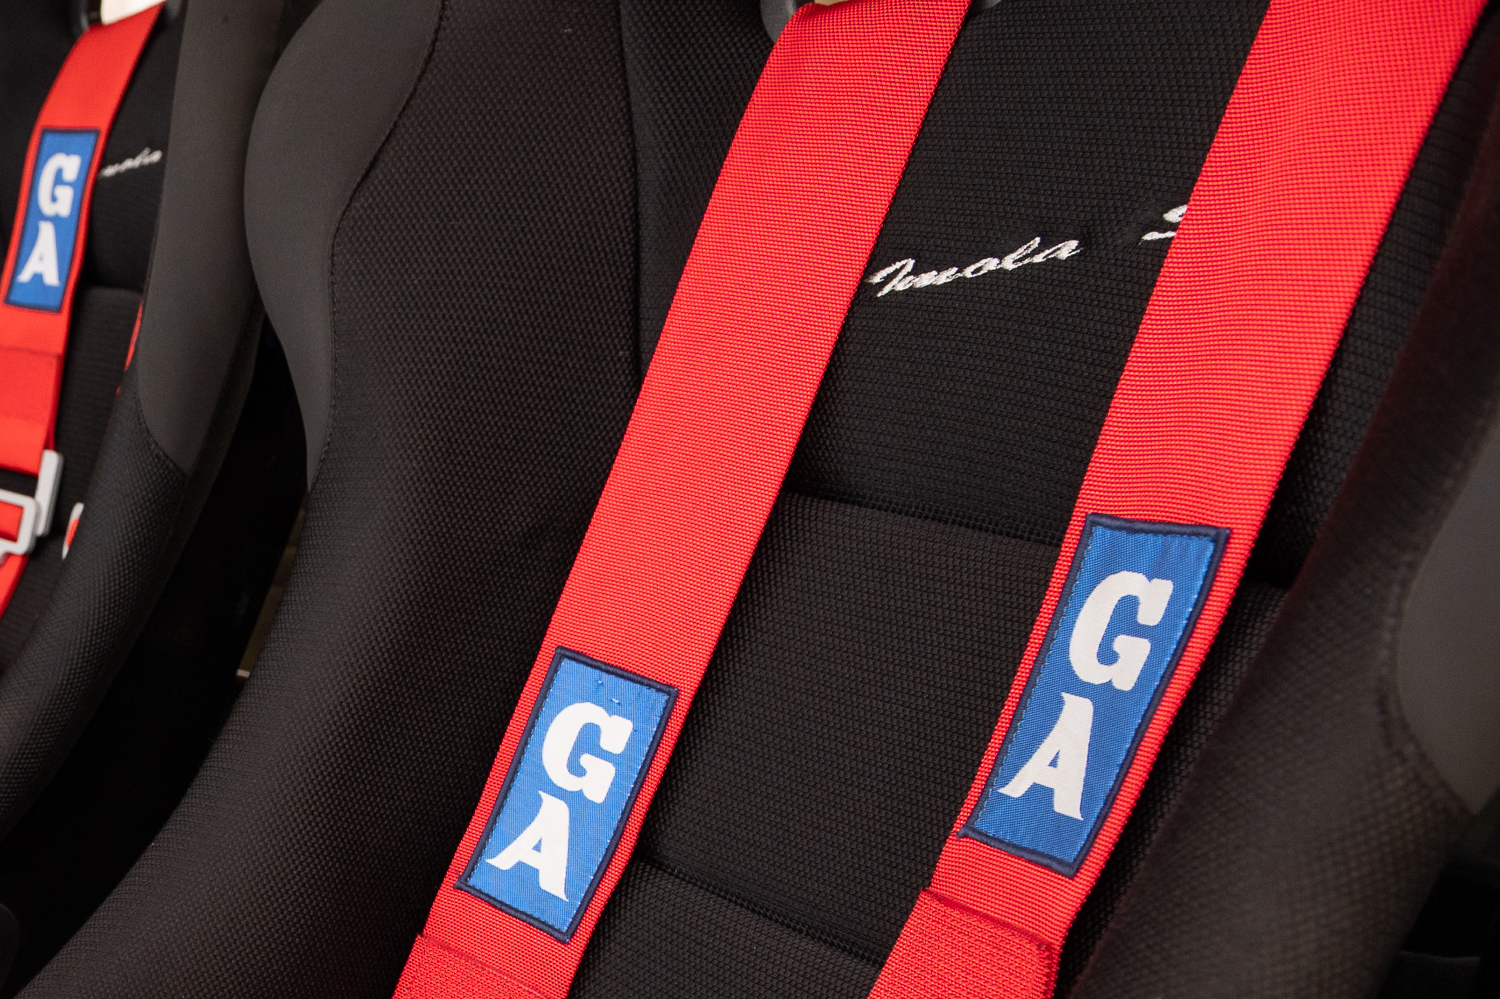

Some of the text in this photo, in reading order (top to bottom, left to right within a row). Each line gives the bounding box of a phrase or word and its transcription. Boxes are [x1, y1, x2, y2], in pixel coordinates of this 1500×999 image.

[15, 152, 82, 287] GA
[998, 569, 1174, 821] GA
[485, 701, 633, 902] GA
